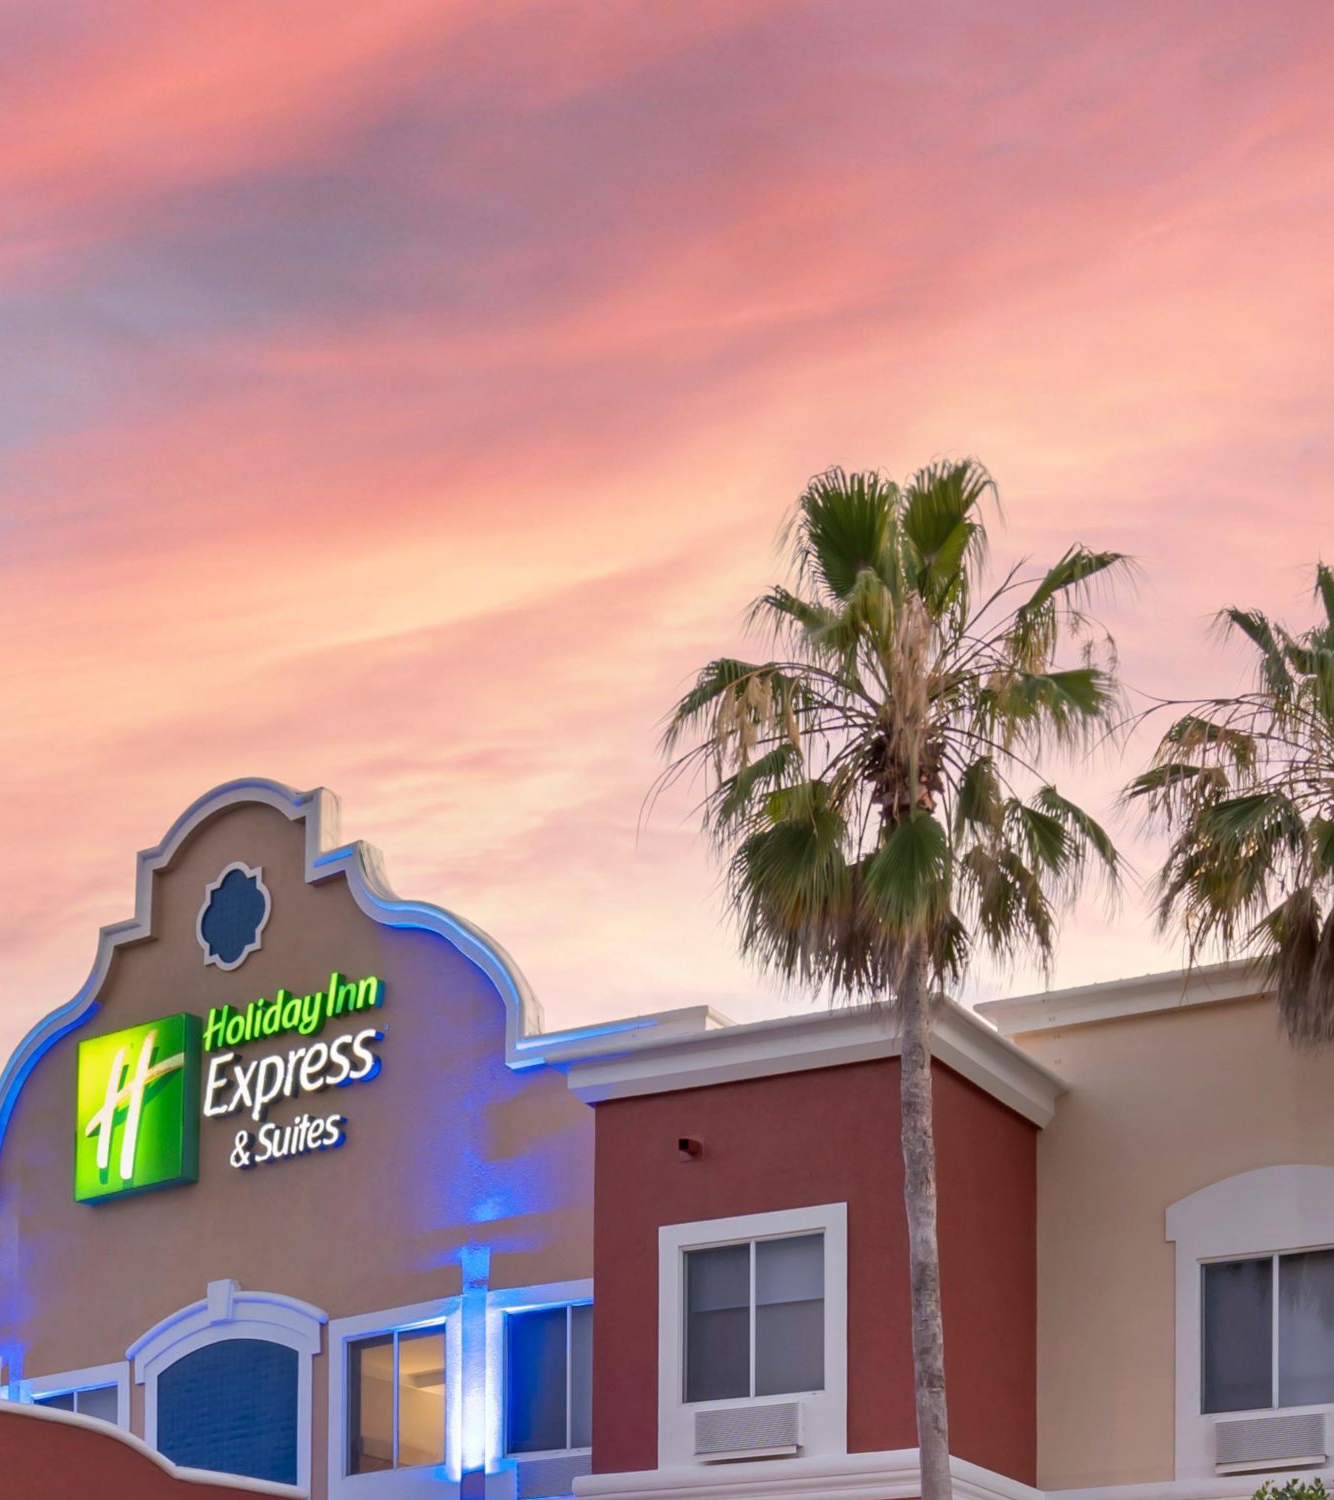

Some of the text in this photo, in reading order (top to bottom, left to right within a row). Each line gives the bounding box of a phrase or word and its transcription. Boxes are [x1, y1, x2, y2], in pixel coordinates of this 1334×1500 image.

[203, 971, 378, 1051] Holiday Inn
[203, 1028, 376, 1121] Express
[230, 1114, 341, 1168] & Suites
